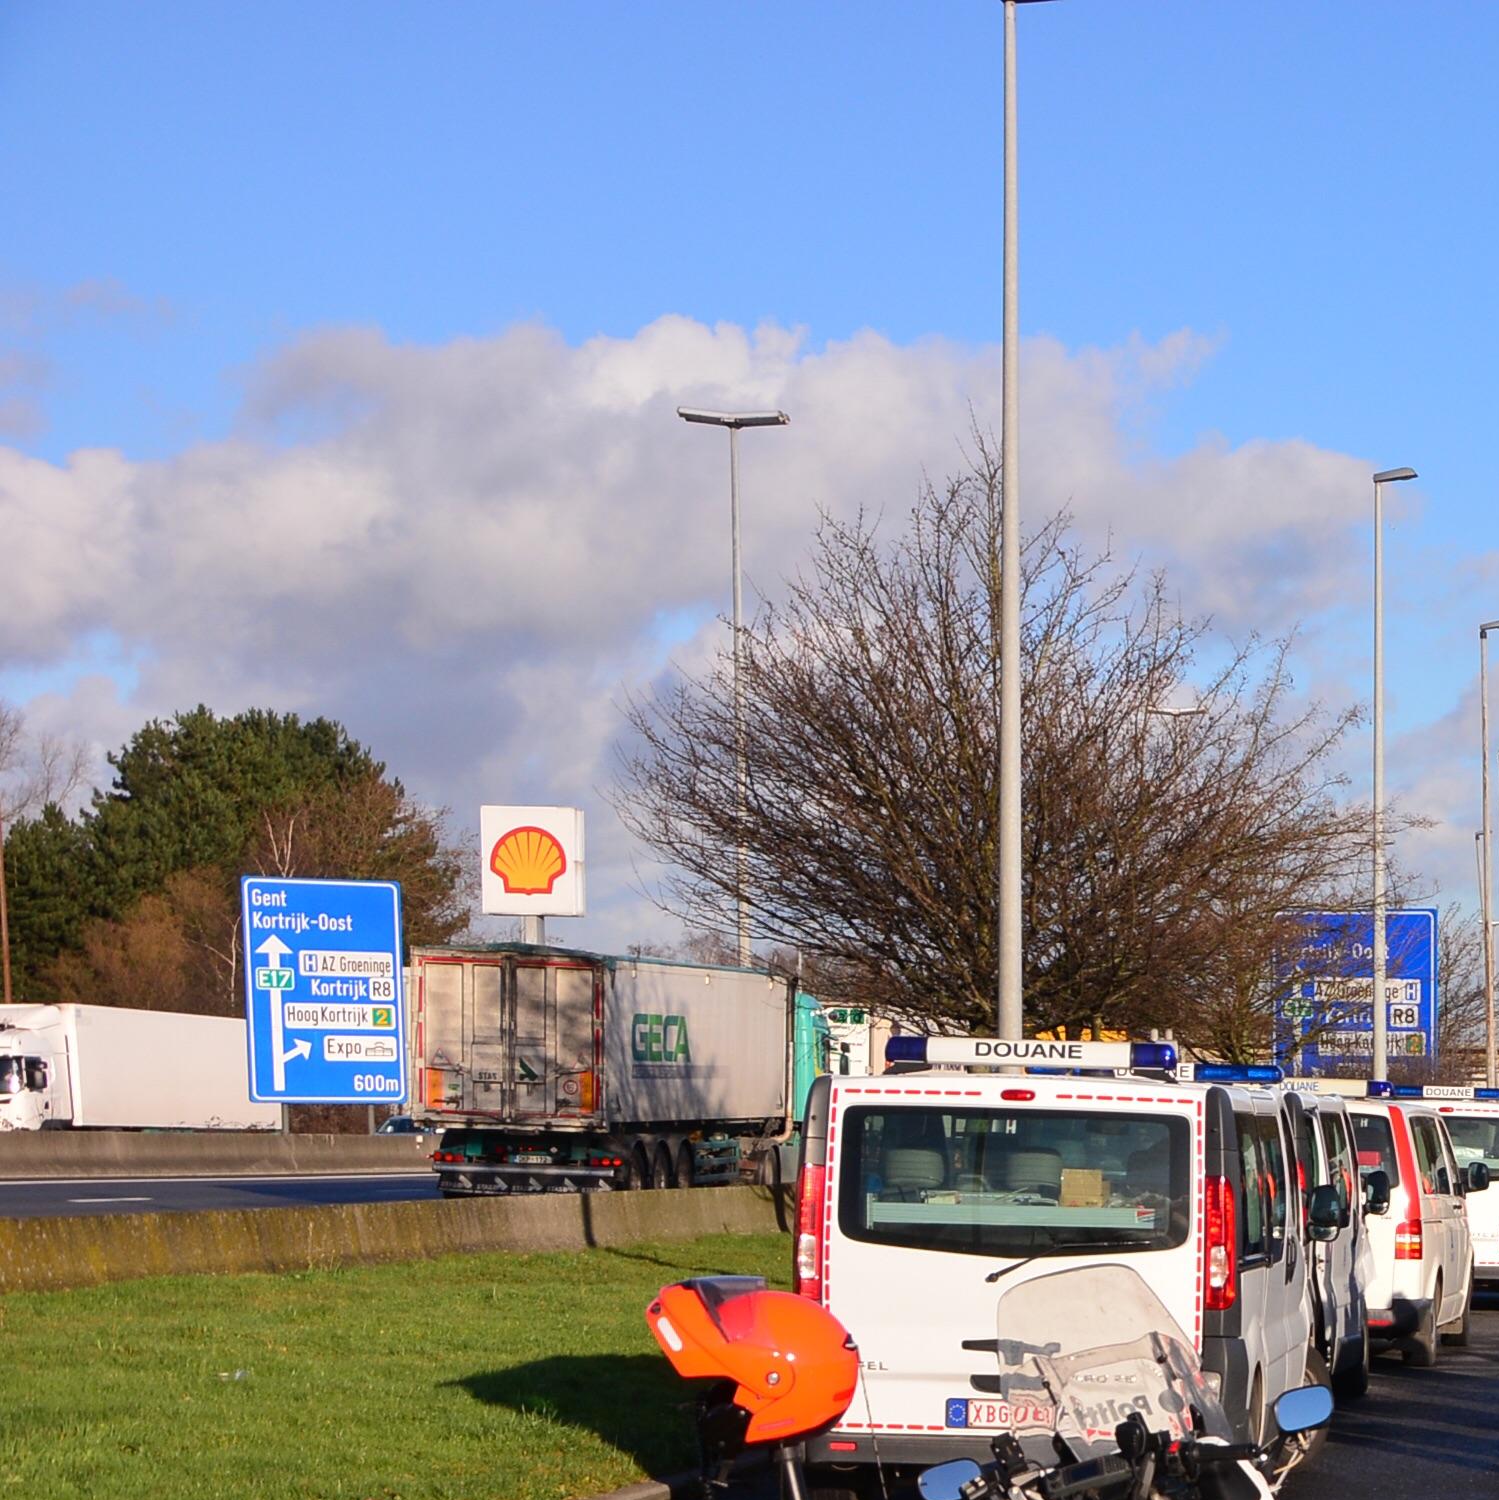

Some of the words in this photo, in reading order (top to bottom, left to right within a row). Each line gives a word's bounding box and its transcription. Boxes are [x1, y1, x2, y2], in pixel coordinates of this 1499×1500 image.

[251, 888, 287, 907] Gent
[252, 911, 353, 933] Kortrijk-Oost
[321, 957, 336, 972] AZ
[339, 957, 391, 977] Groeninge
[258, 970, 292, 987] E17
[311, 978, 368, 1000] Kortrijk
[372, 981, 391, 997] R8
[286, 1006, 319, 1026] Hoog
[321, 1006, 368, 1027] Kortrijk
[375, 1009, 388, 1026] 2
[1392, 1007, 1416, 1025] R8
[631, 1012, 692, 1063] GECA
[327, 1038, 362, 1058] Expo
[974, 1041, 1083, 1060] DOUANE
[353, 1074, 399, 1092] 600m
[1279, 1080, 1320, 1091] DOUANE
[1425, 1086, 1472, 1098] DOUANE
